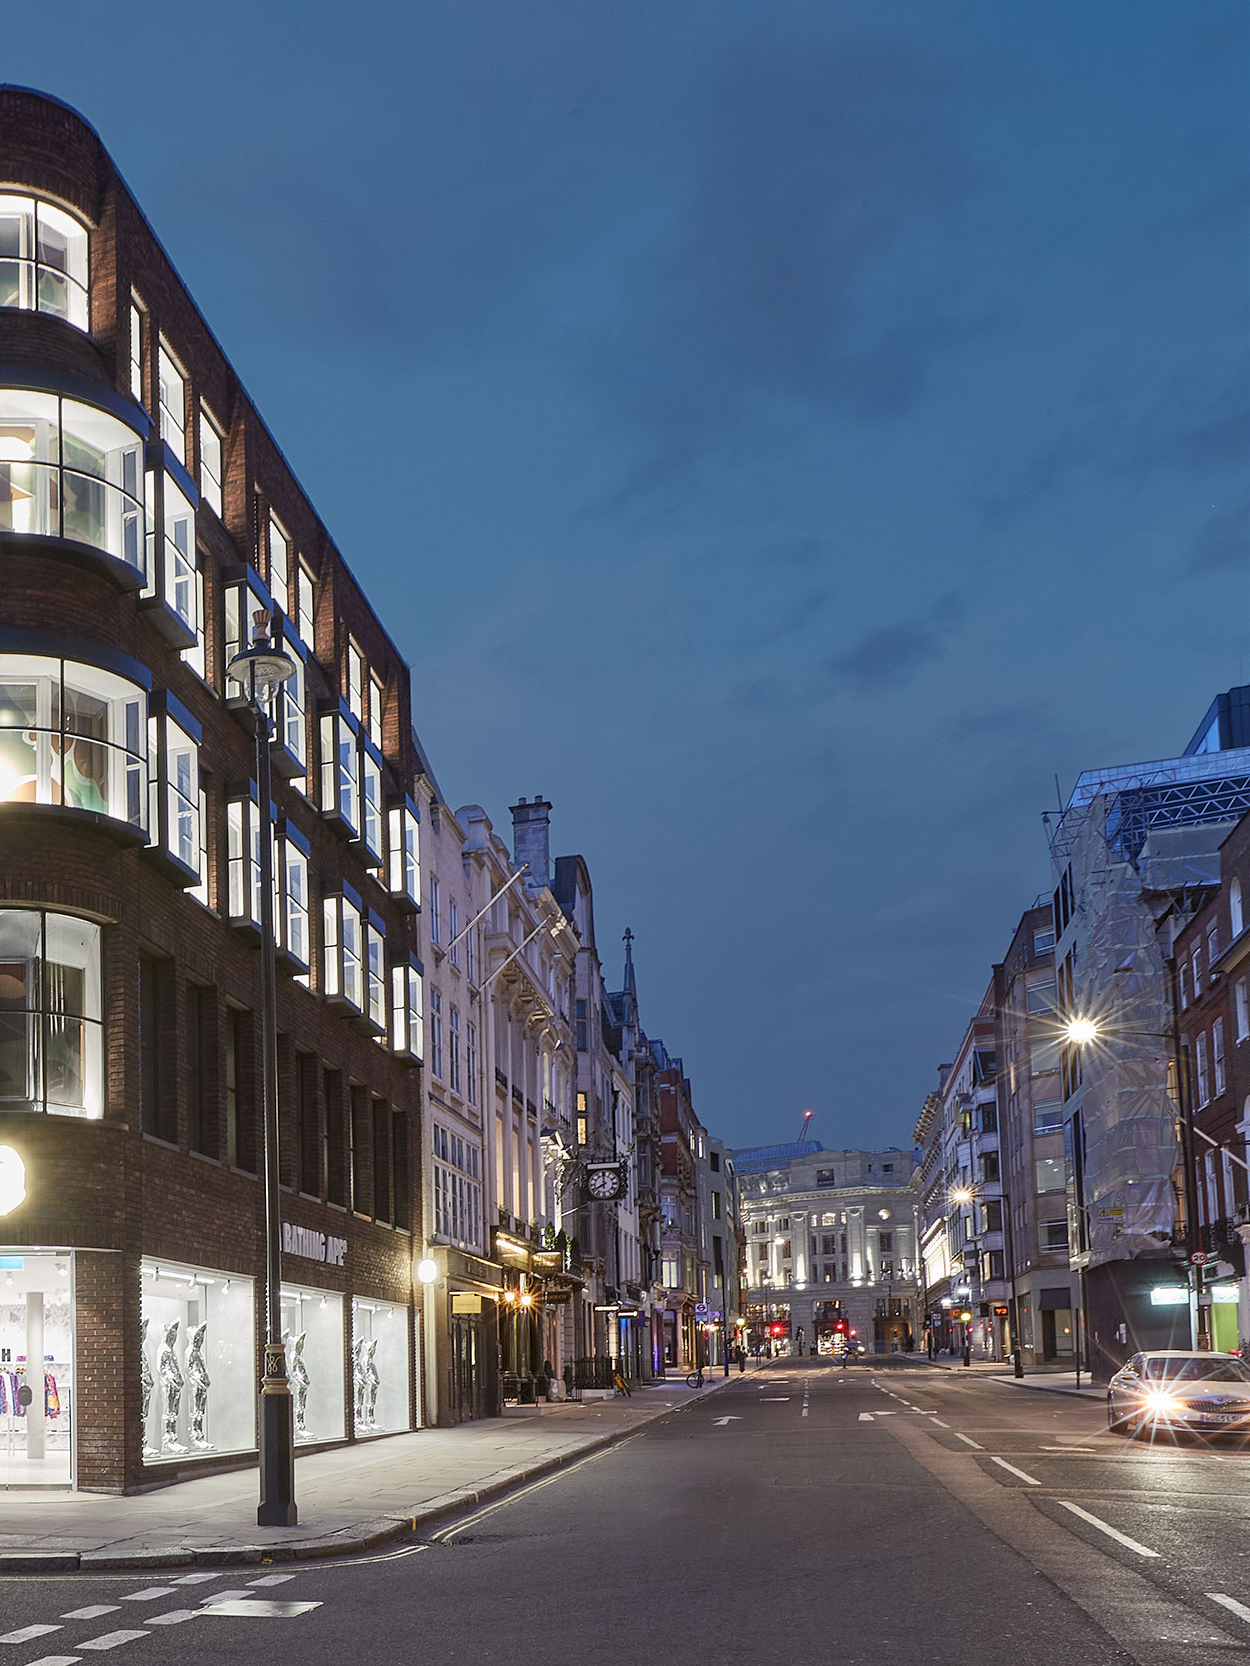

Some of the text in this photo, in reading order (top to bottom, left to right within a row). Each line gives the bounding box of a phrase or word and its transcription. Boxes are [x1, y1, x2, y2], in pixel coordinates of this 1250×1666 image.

[282, 1222, 326, 1262] BATHING
[1193, 1254, 1206, 1262] 20
[1, 1348, 11, 1362] H
